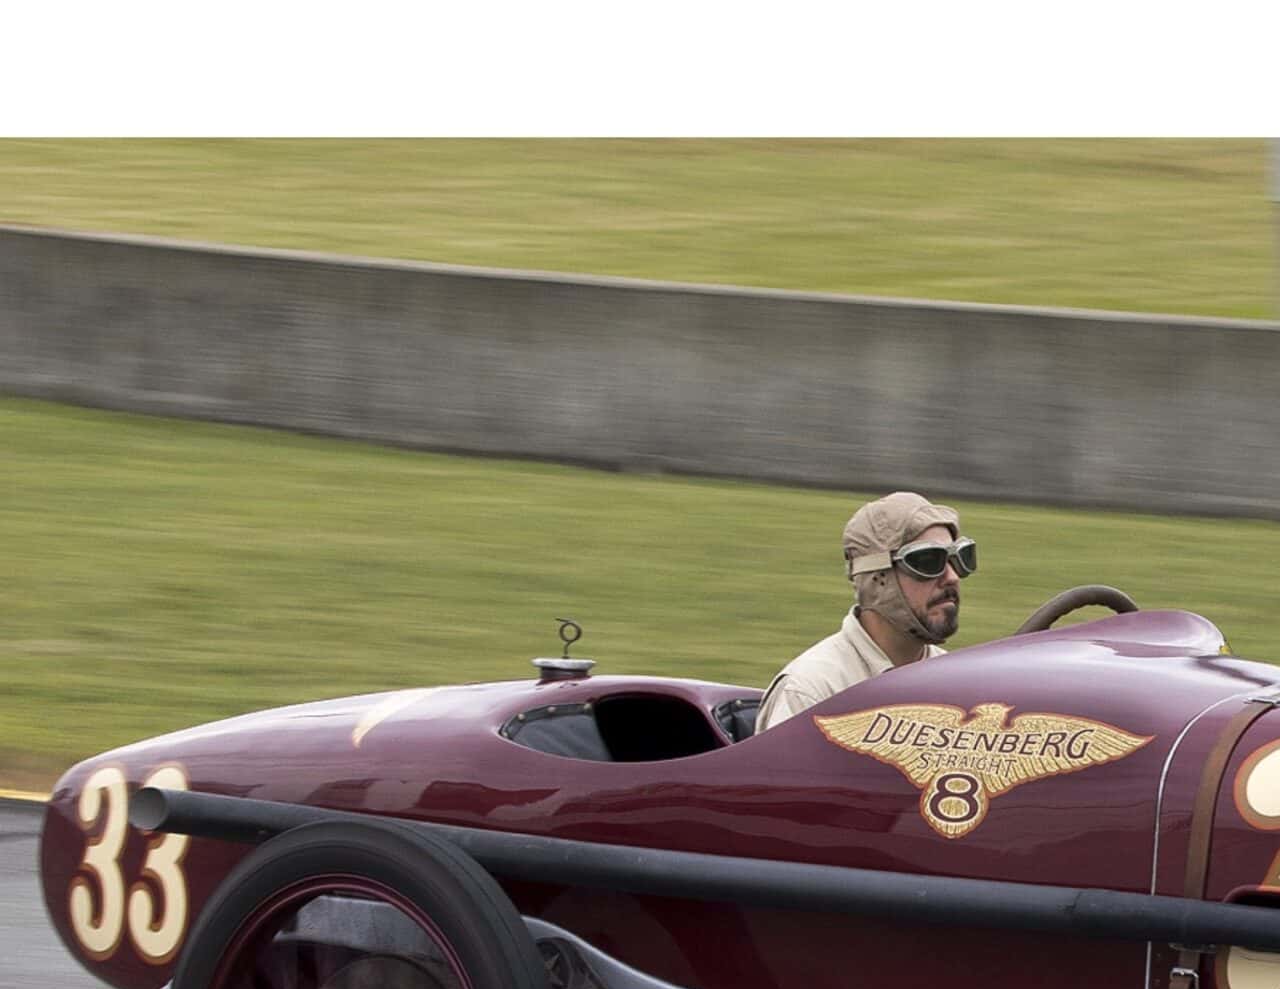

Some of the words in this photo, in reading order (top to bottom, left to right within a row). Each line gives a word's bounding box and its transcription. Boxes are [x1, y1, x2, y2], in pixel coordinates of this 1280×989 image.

[861, 712, 1094, 760] DUESENBERG
[917, 752, 1018, 778] STRAIGHT
[928, 772, 980, 823] 8
[68, 761, 191, 965] 33
